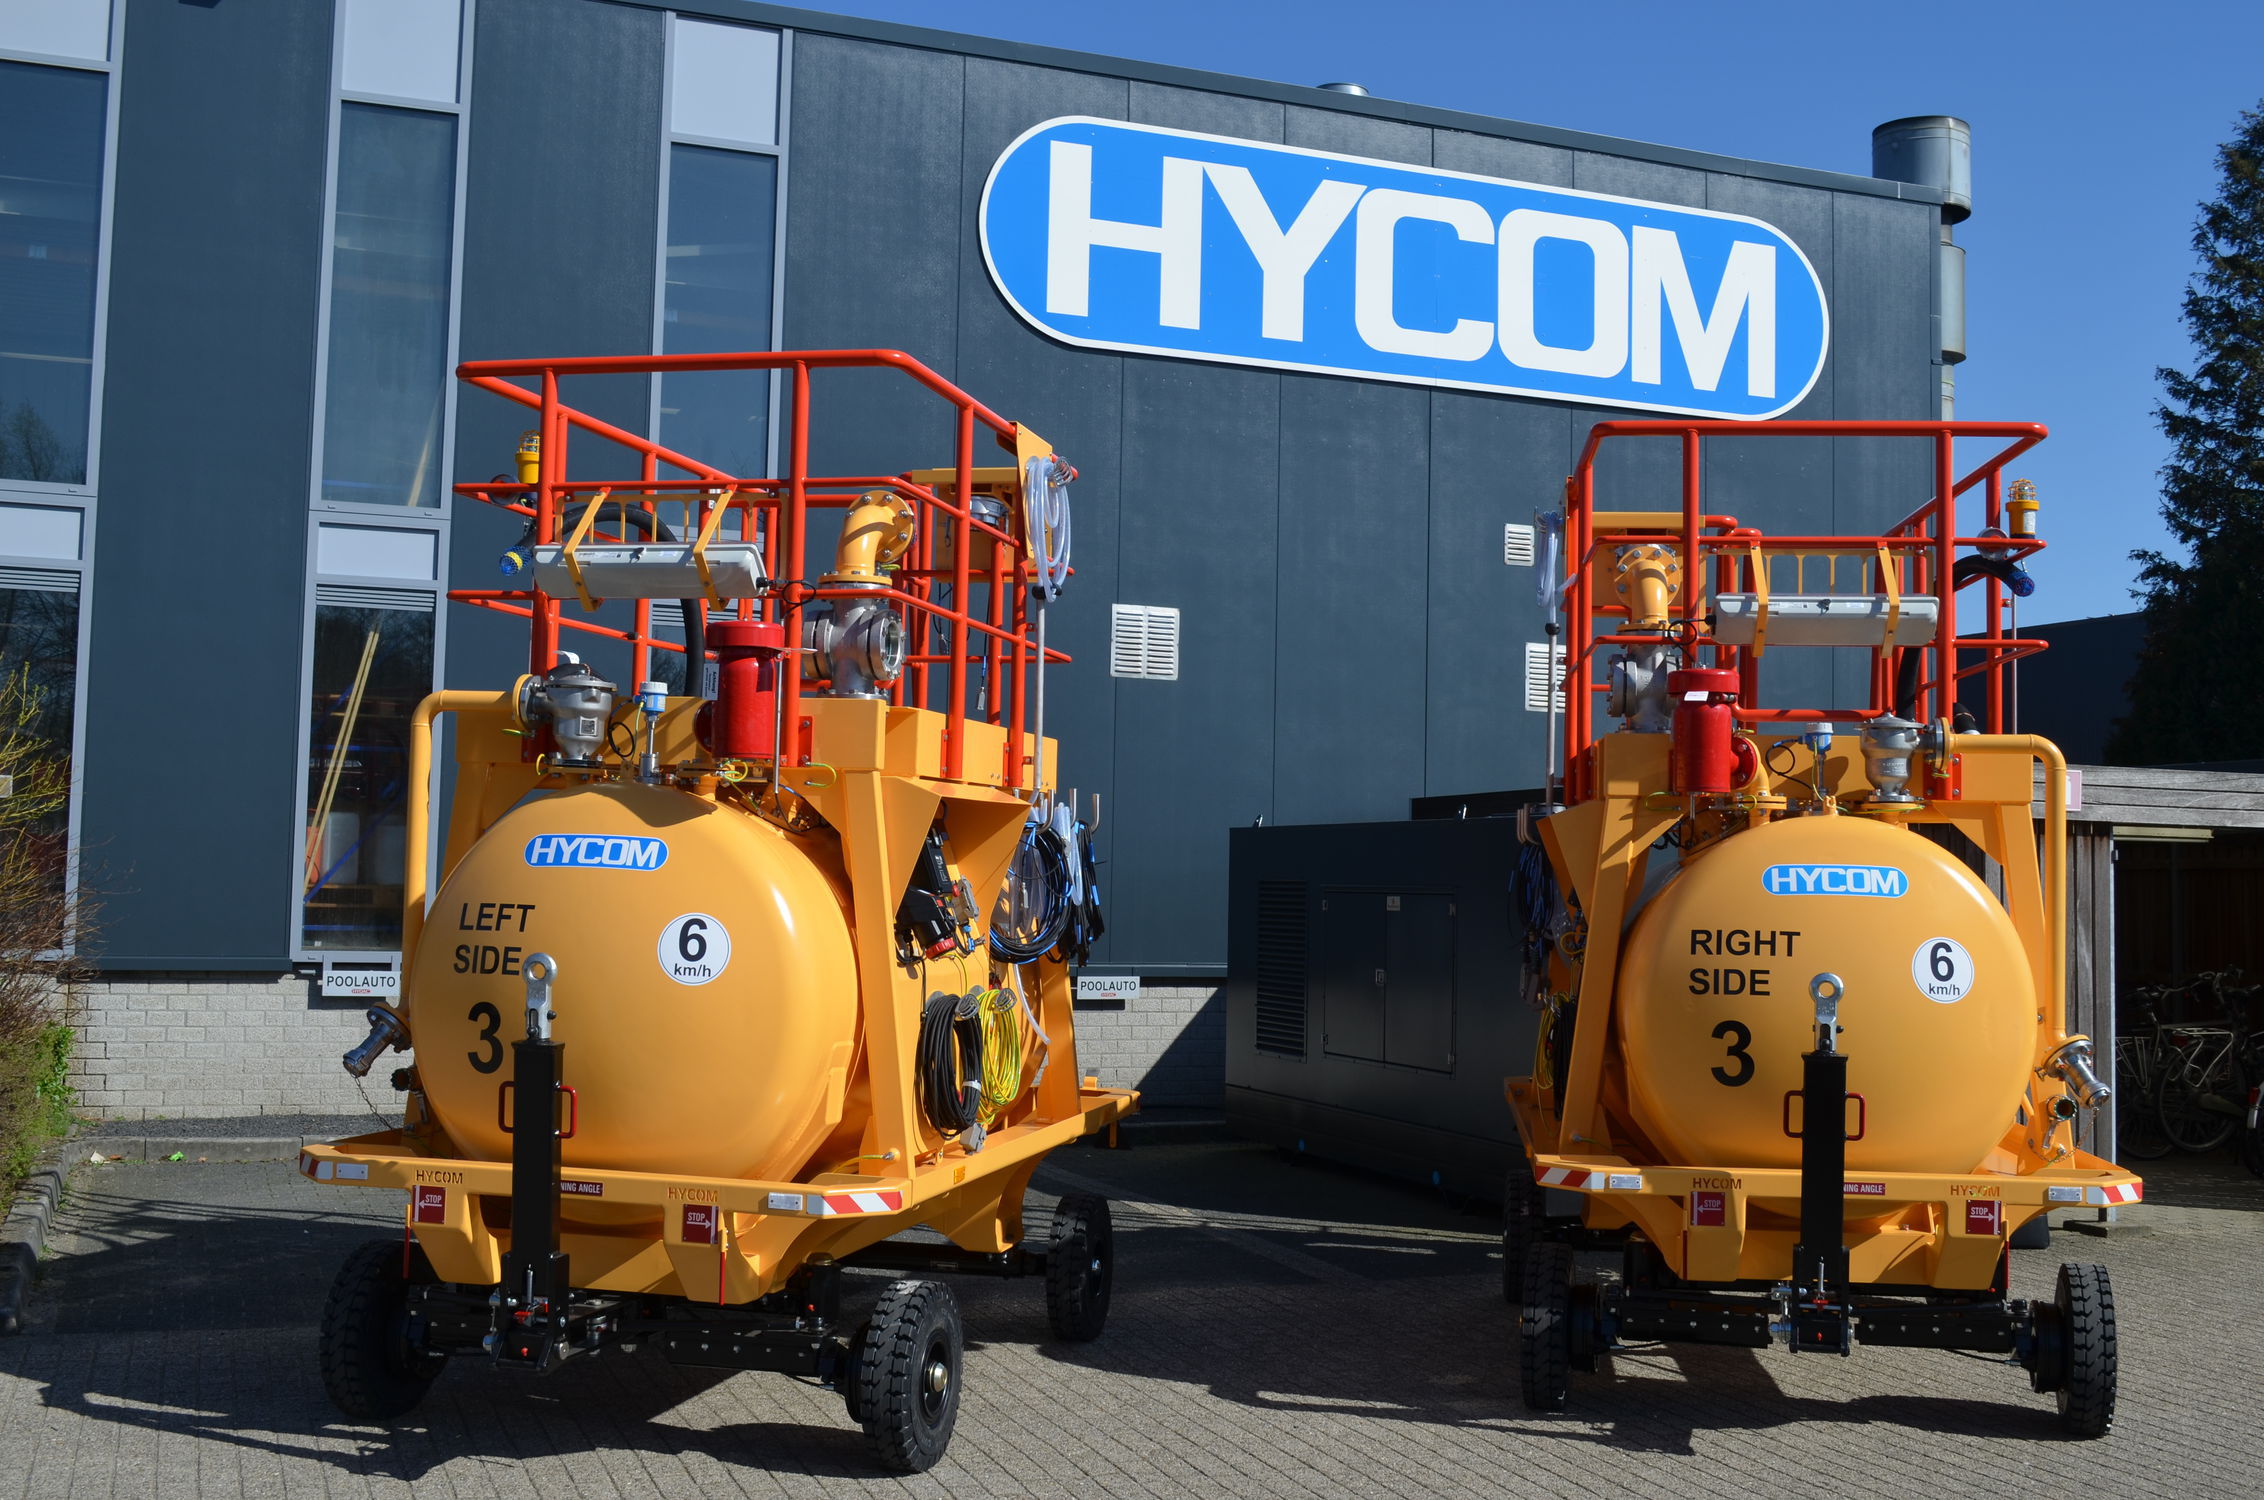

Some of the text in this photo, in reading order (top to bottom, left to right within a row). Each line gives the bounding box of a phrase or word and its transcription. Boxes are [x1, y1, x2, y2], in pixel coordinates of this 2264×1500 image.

[1046, 140, 1776, 399] HYCOM
[530, 837, 660, 868] HYCOM
[1771, 867, 1900, 895] HYCOM
[459, 903, 535, 932] LEFT
[678, 917, 708, 962] 6
[1690, 929, 1801, 957] RIGHT
[453, 944, 522, 976] SIDE
[1929, 942, 1955, 982] 6
[674, 963, 712, 978] km/h
[326, 975, 396, 988] POOLAUTO
[1080, 981, 1137, 991] POOLAUTO
[1688, 968, 1771, 996] SIDE
[1928, 983, 1961, 996] km/h
[467, 1001, 504, 1074] 3
[1711, 1020, 1755, 1087] 3
[416, 1169, 463, 1185] HYCOM
[1692, 1177, 1742, 1190] HYCOM
[578, 1183, 601, 1194] ANGLE
[668, 1186, 718, 1202] HYCOM
[1860, 1184, 1883, 1193] ANGLE
[1950, 1184, 2000, 1197] HYCOM
[425, 1193, 443, 1204] STOP
[1703, 1199, 1721, 1208] STOP
[687, 1211, 706, 1221] STOP
[1970, 1206, 1989, 1215] STOP
